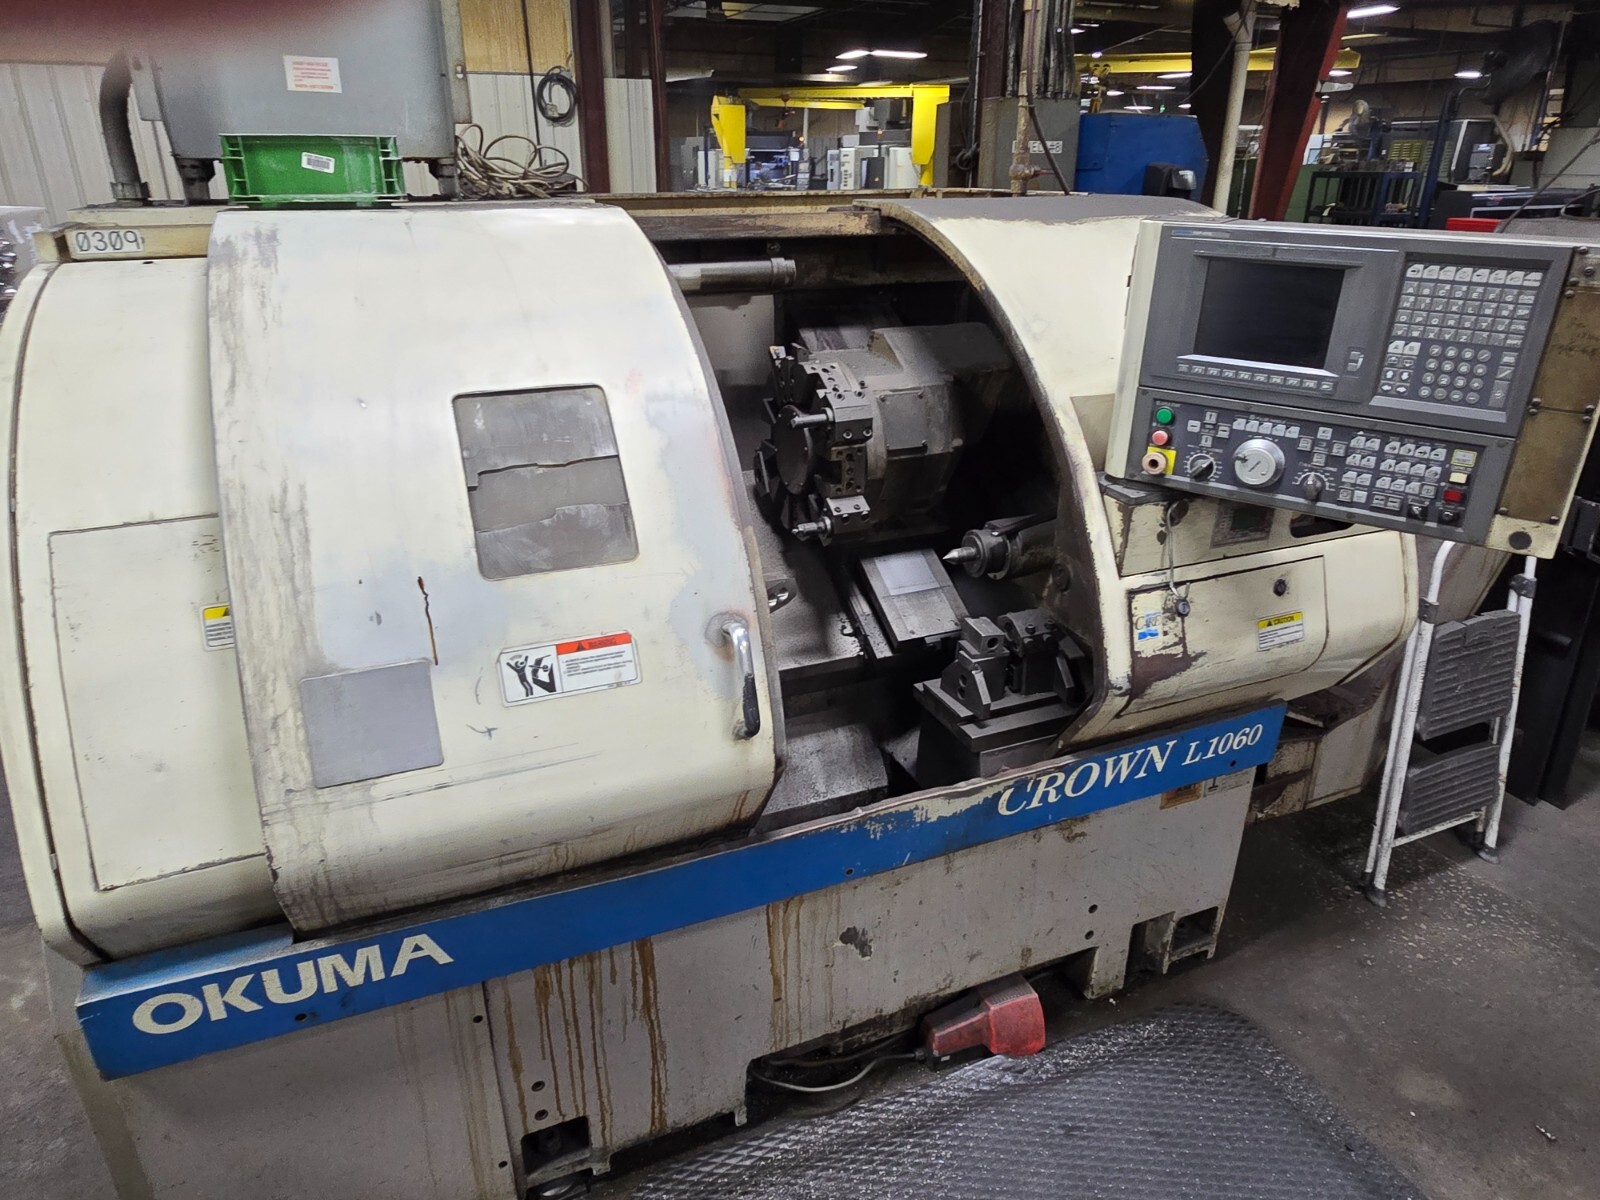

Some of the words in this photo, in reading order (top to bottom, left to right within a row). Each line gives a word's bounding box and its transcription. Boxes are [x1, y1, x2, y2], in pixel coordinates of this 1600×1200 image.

[997, 740, 1178, 816] CROWN
[1182, 723, 1264, 766] L1060
[132, 933, 454, 1035] OKUMA
